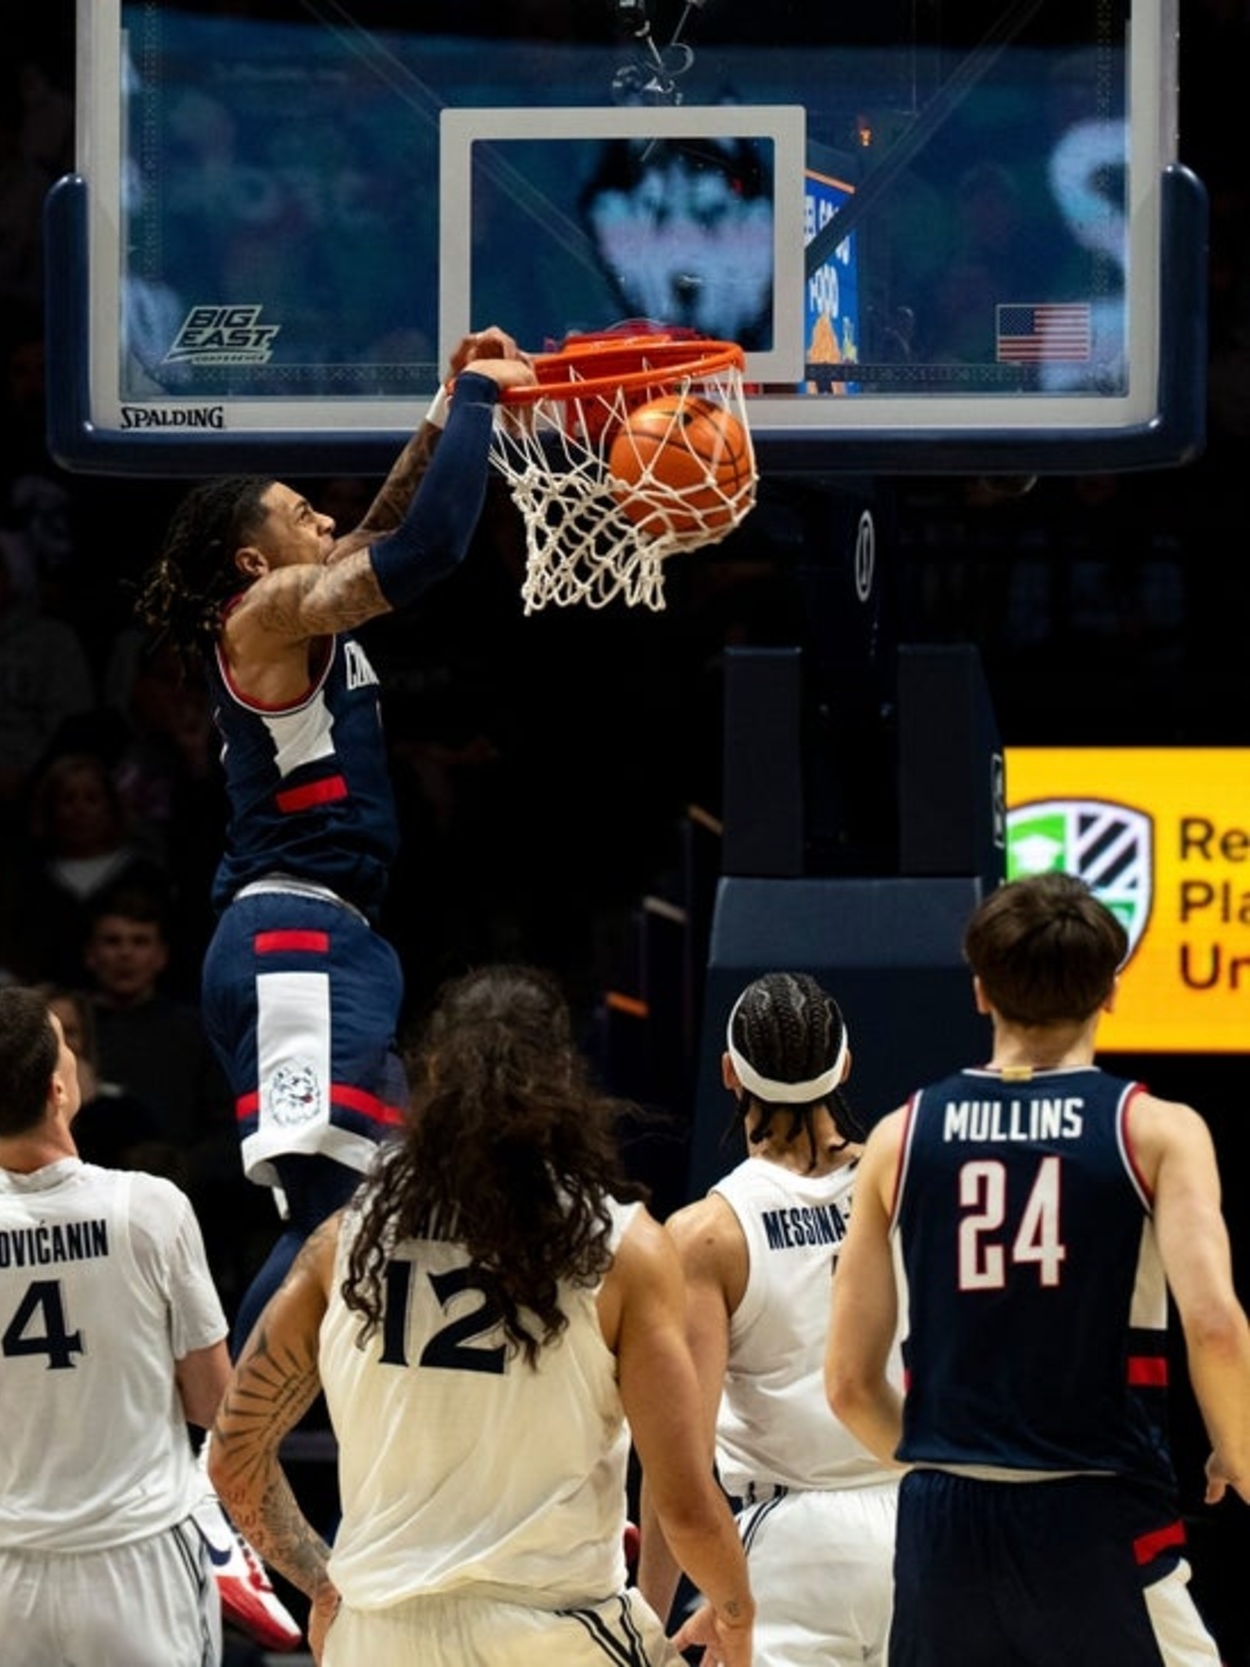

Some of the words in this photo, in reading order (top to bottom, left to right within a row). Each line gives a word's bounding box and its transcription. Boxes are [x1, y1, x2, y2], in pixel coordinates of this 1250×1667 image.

[175, 329, 273, 347] EAST
[186, 308, 256, 328] BIG
[120, 406, 225, 430] SPALDING
[1180, 816, 1250, 863] Re
[943, 1098, 1084, 1142] MULLINS
[762, 1197, 852, 1250] MESSINA-
[958, 1155, 1067, 1291] 24
[1, 1279, 85, 1370] 4
[378, 1259, 508, 1375] 12
